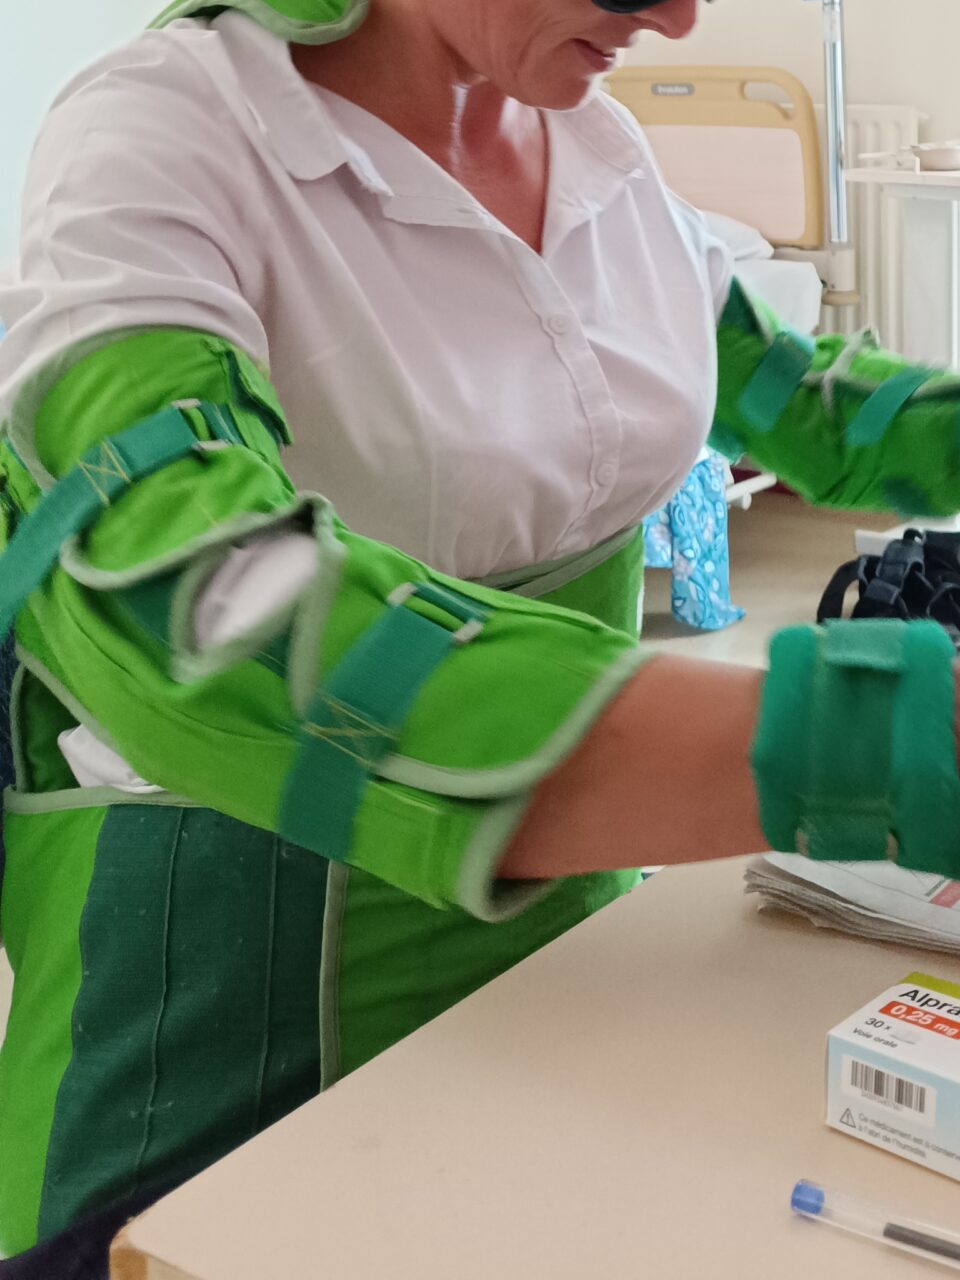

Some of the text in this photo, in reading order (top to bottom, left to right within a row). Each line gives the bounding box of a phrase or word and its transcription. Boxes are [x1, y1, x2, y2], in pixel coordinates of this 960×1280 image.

[864, 1017, 884, 1029] 30
[889, 1005, 960, 1037] 0,25 mg
[852, 1027, 898, 1049] Voie orale
